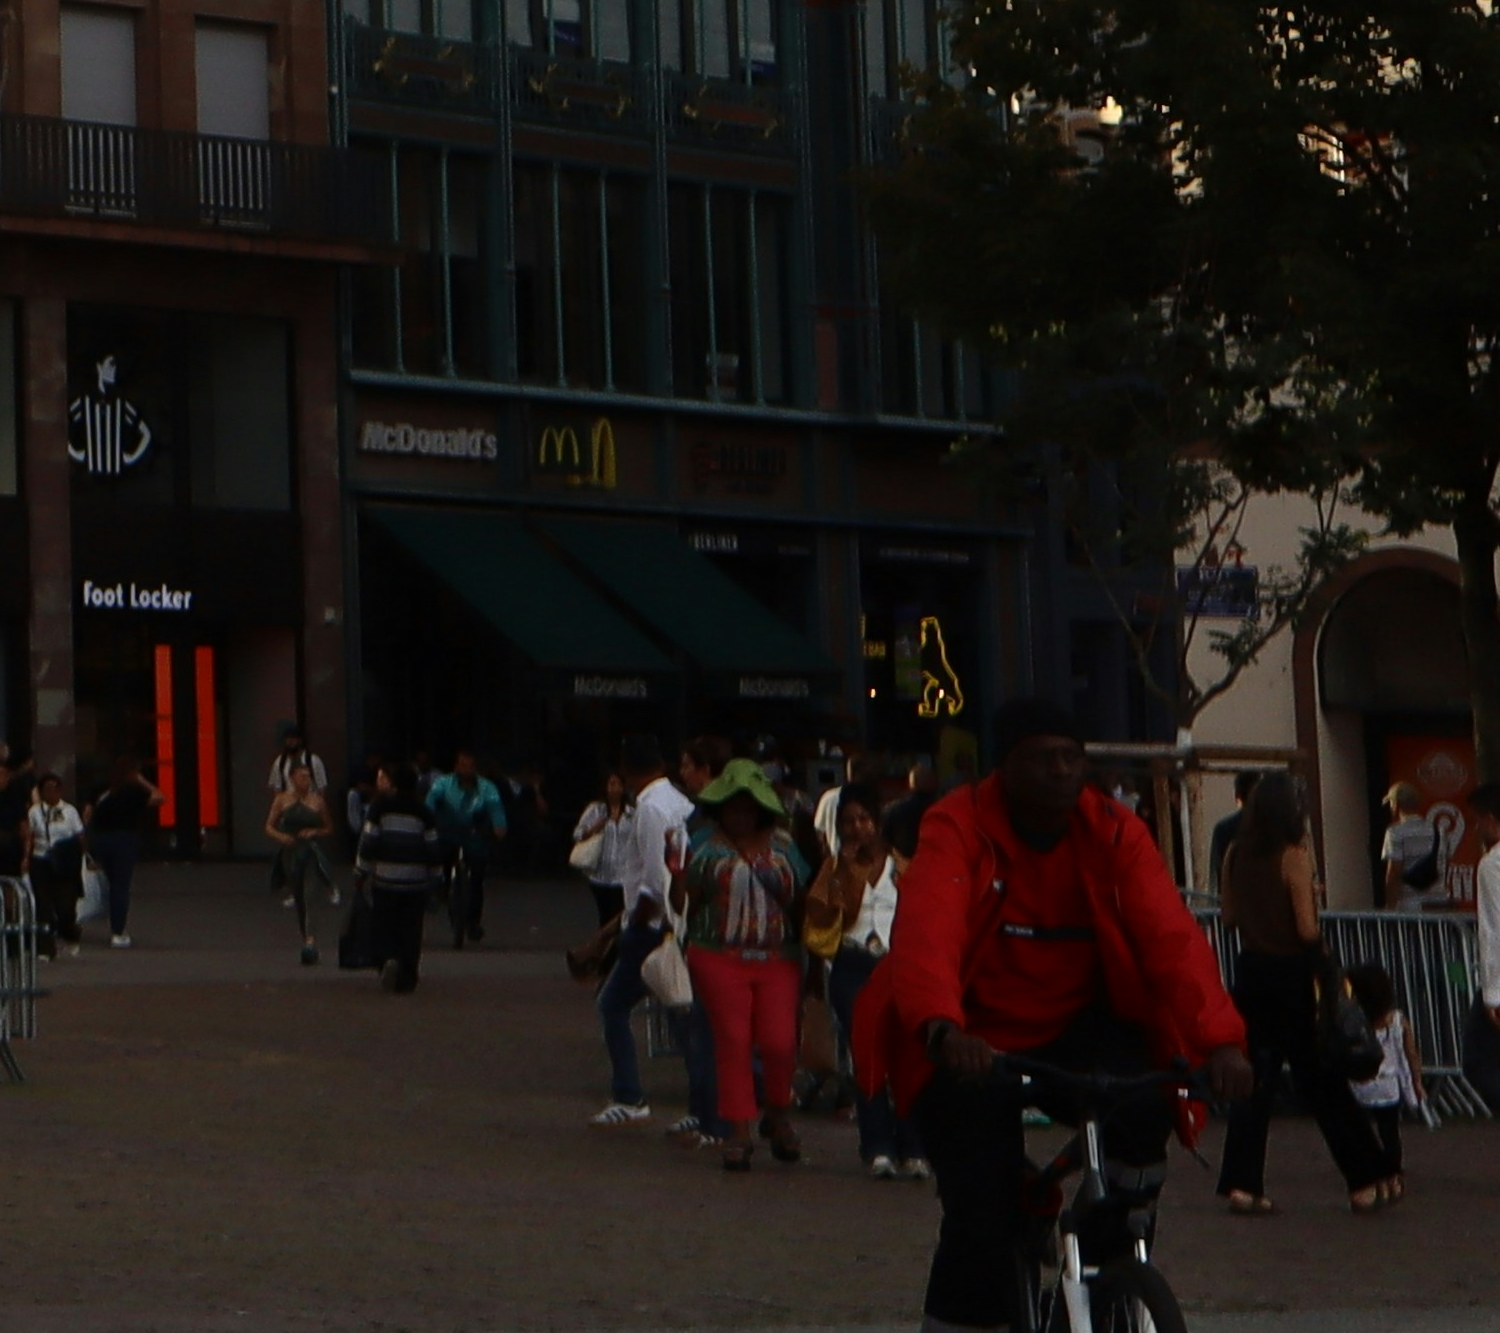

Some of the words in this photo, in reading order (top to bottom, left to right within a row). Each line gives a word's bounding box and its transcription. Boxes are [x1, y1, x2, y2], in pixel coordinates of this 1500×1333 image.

[360, 421, 497, 459] McDonald's
[83, 579, 124, 608] Foot
[129, 581, 192, 611] Locker
